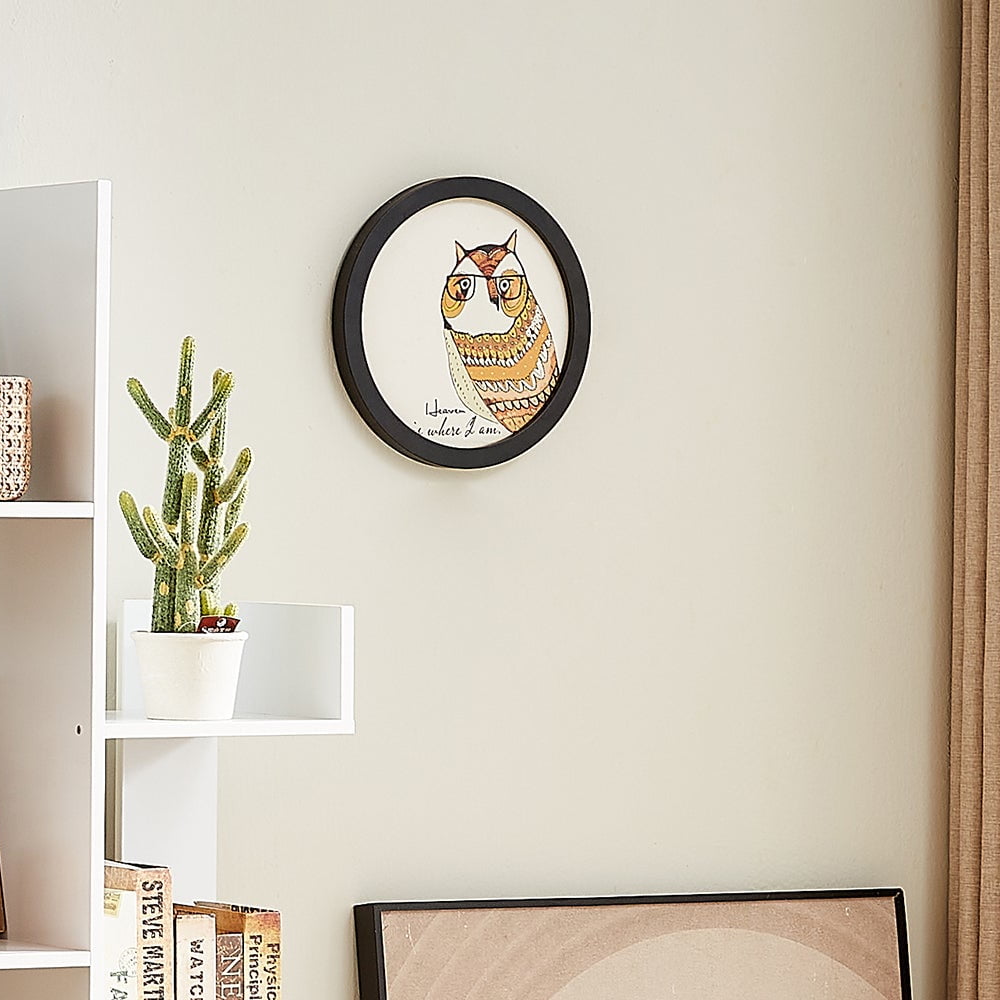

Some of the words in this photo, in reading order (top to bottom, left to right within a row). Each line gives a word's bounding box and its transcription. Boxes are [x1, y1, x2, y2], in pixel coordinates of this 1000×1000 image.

[425, 398, 466, 417] Heaven
[427, 416, 462, 437] where
[141, 879, 164, 940] STEVE
